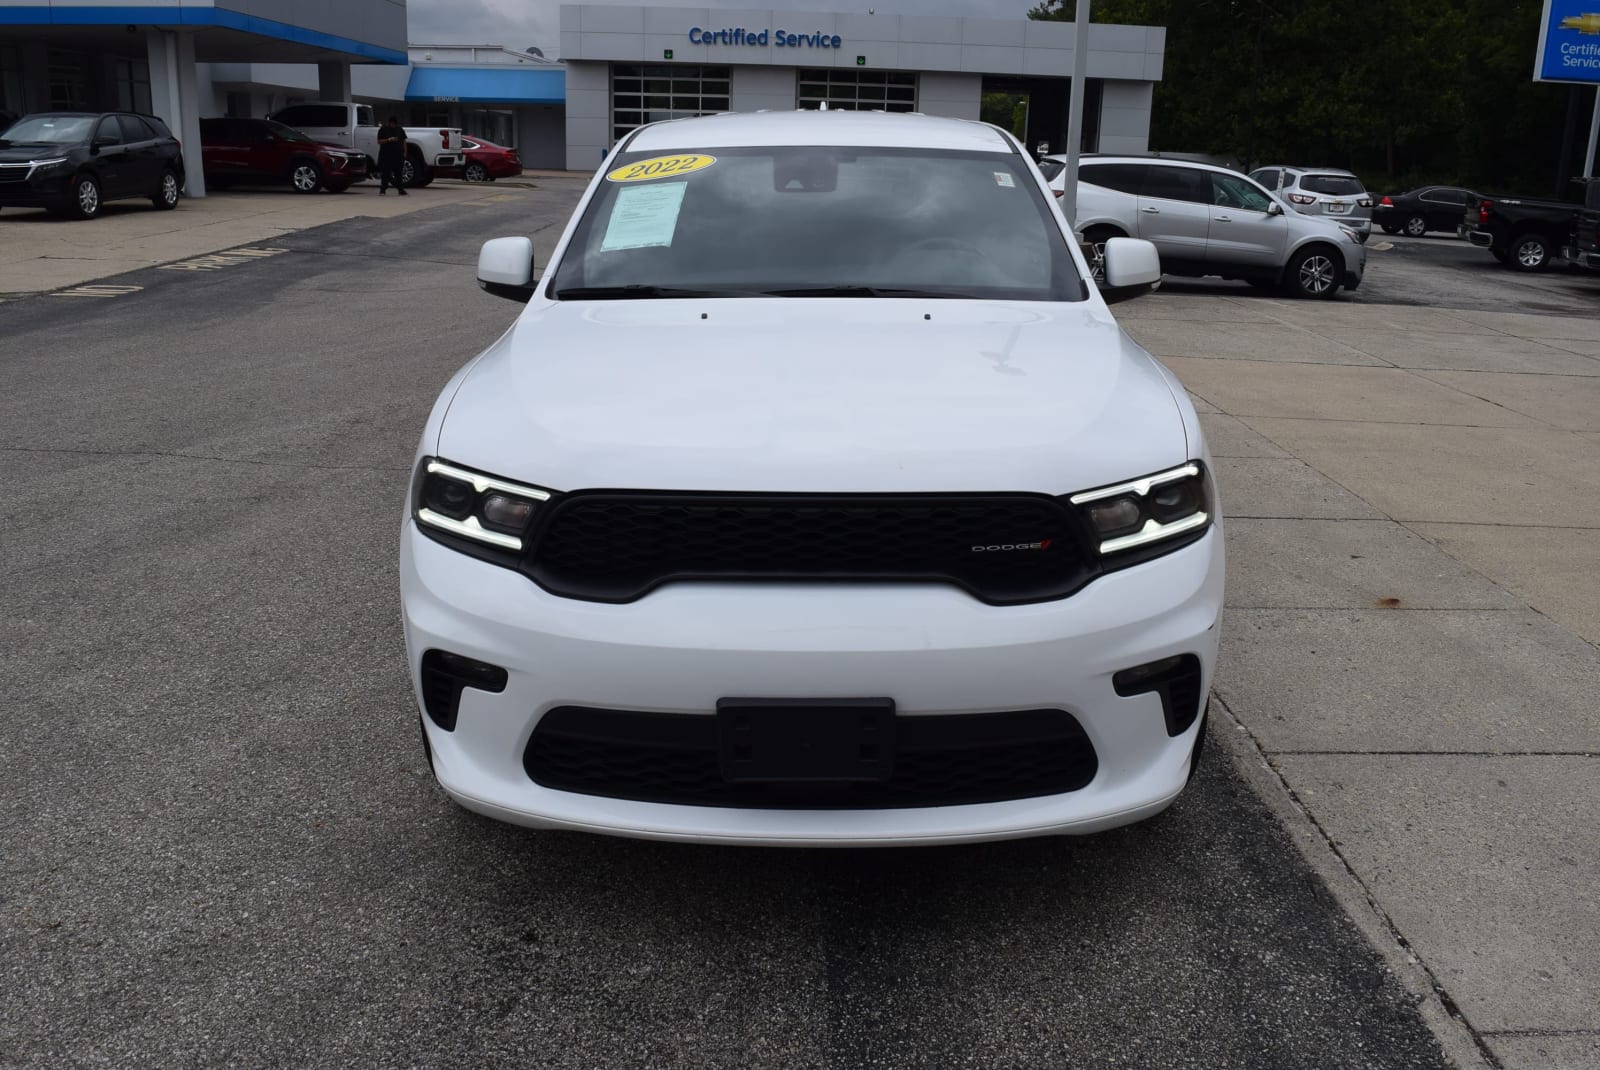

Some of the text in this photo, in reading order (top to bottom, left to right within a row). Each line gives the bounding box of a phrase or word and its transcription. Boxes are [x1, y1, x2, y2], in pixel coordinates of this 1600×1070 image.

[689, 27, 842, 48] Certified Service
[1562, 55, 1600, 68] Servic
[625, 157, 698, 178] 2022
[971, 543, 1042, 552] DODGE
